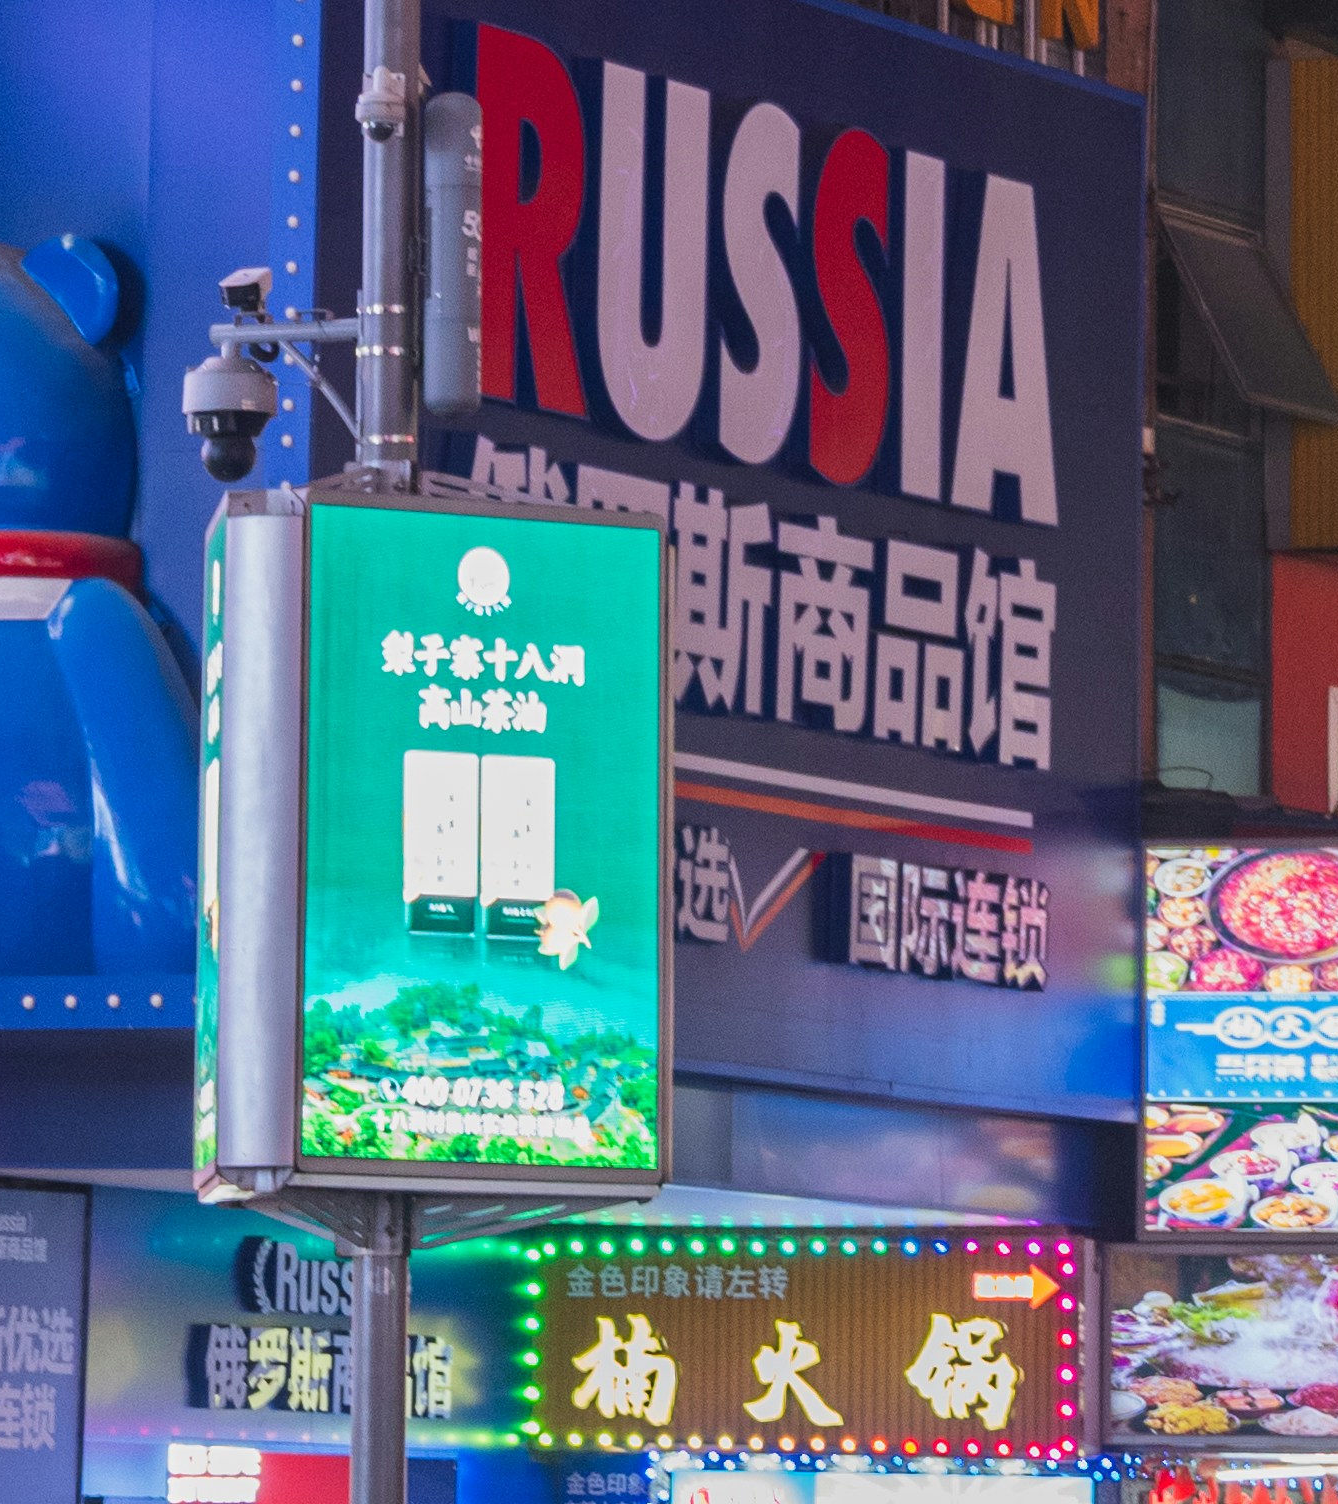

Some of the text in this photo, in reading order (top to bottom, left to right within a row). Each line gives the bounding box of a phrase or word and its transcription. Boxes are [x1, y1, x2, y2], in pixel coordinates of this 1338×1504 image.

[477, 21, 1058, 527] RUSSIA
[418, 685, 547, 734] 高山茶油
[849, 853, 1047, 991] 国际连锁
[276, 1242, 353, 1316] Russ
[567, 1264, 789, 1301] 金色印象请左转
[572, 1314, 1018, 1431] 楠火锅
